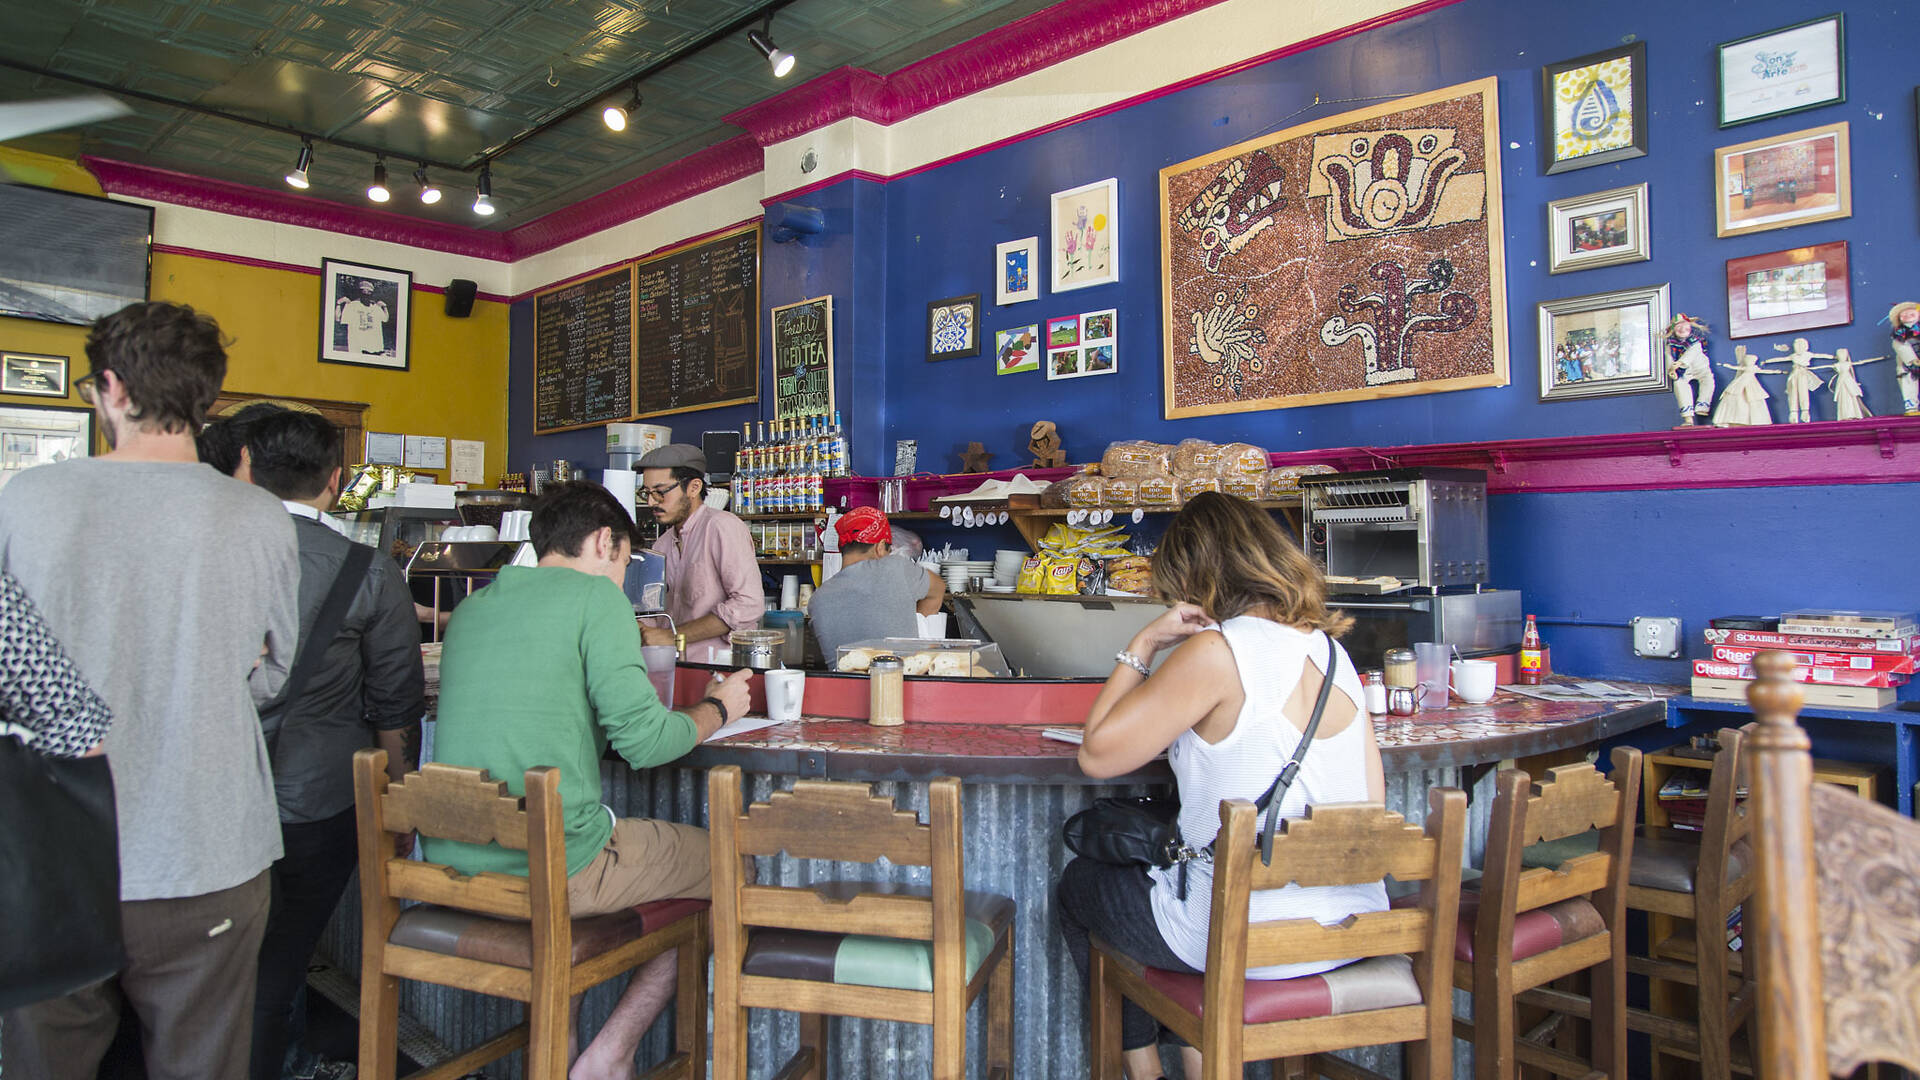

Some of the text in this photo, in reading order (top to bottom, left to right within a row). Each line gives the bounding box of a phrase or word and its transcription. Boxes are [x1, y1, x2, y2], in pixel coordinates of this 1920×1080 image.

[1762, 68, 1788, 80] Arte
[779, 341, 827, 370] ICED TEA
[1736, 632, 1786, 643] SCRABBLE
[1716, 648, 1756, 661] Chec
[1695, 663, 1738, 675] Chess
